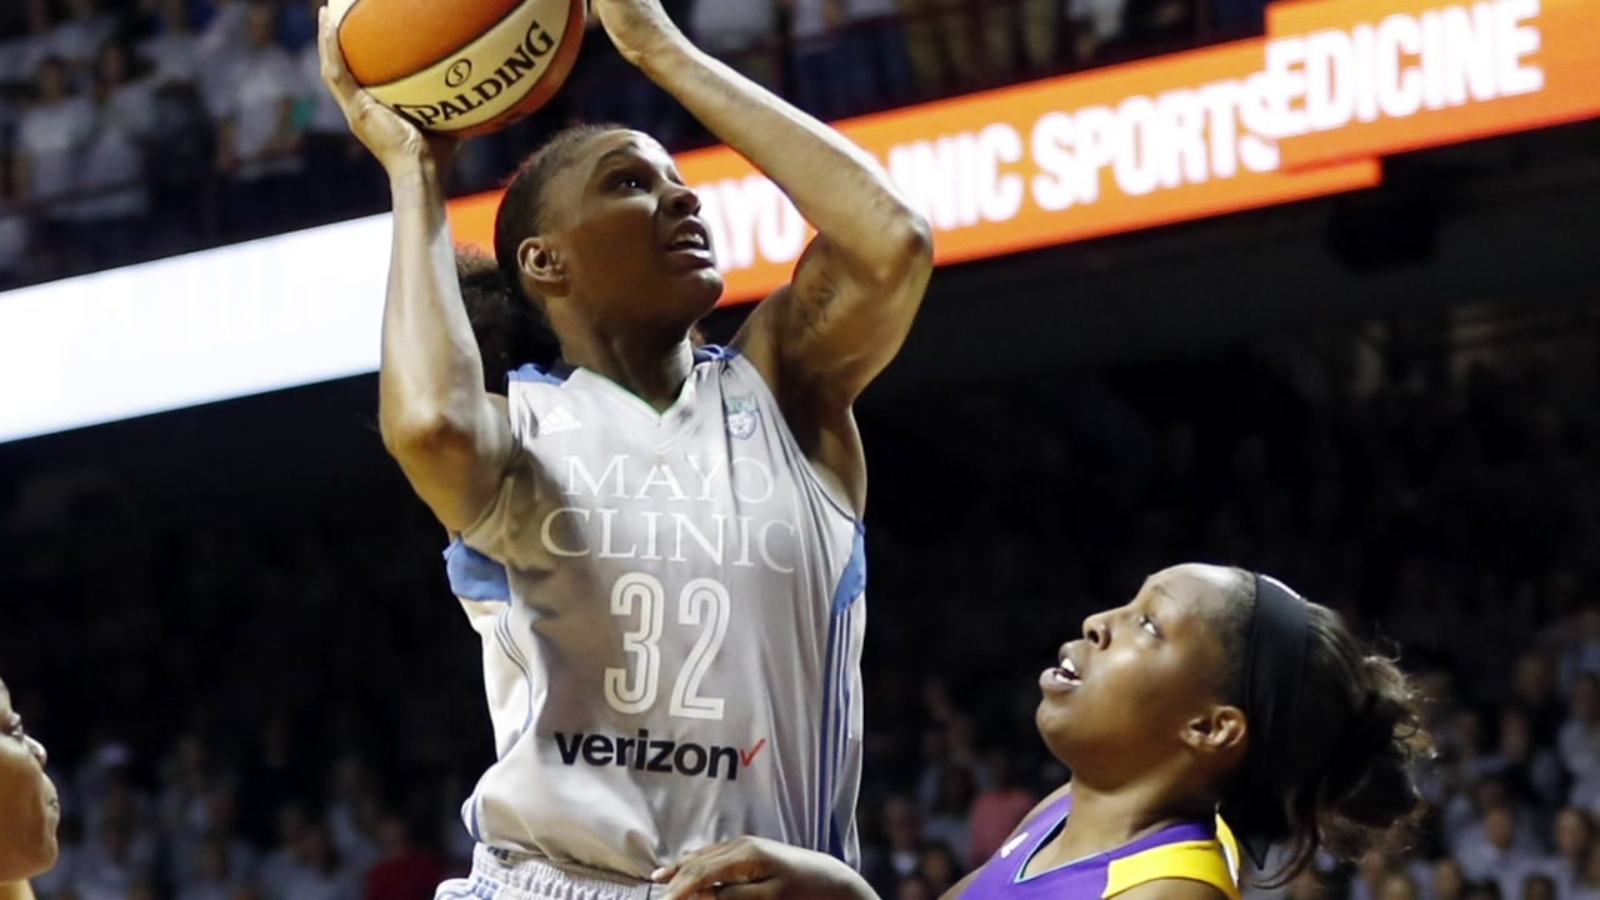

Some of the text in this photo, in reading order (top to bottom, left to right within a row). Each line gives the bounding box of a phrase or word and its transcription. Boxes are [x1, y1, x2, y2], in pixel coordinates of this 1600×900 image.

[1267, 0, 1543, 138] EDICINE
[696, 176, 807, 271] AYO
[561, 453, 774, 504] MAYO
[541, 507, 795, 573] CLINIC
[604, 572, 731, 721] 32
[554, 729, 739, 780] verizon
